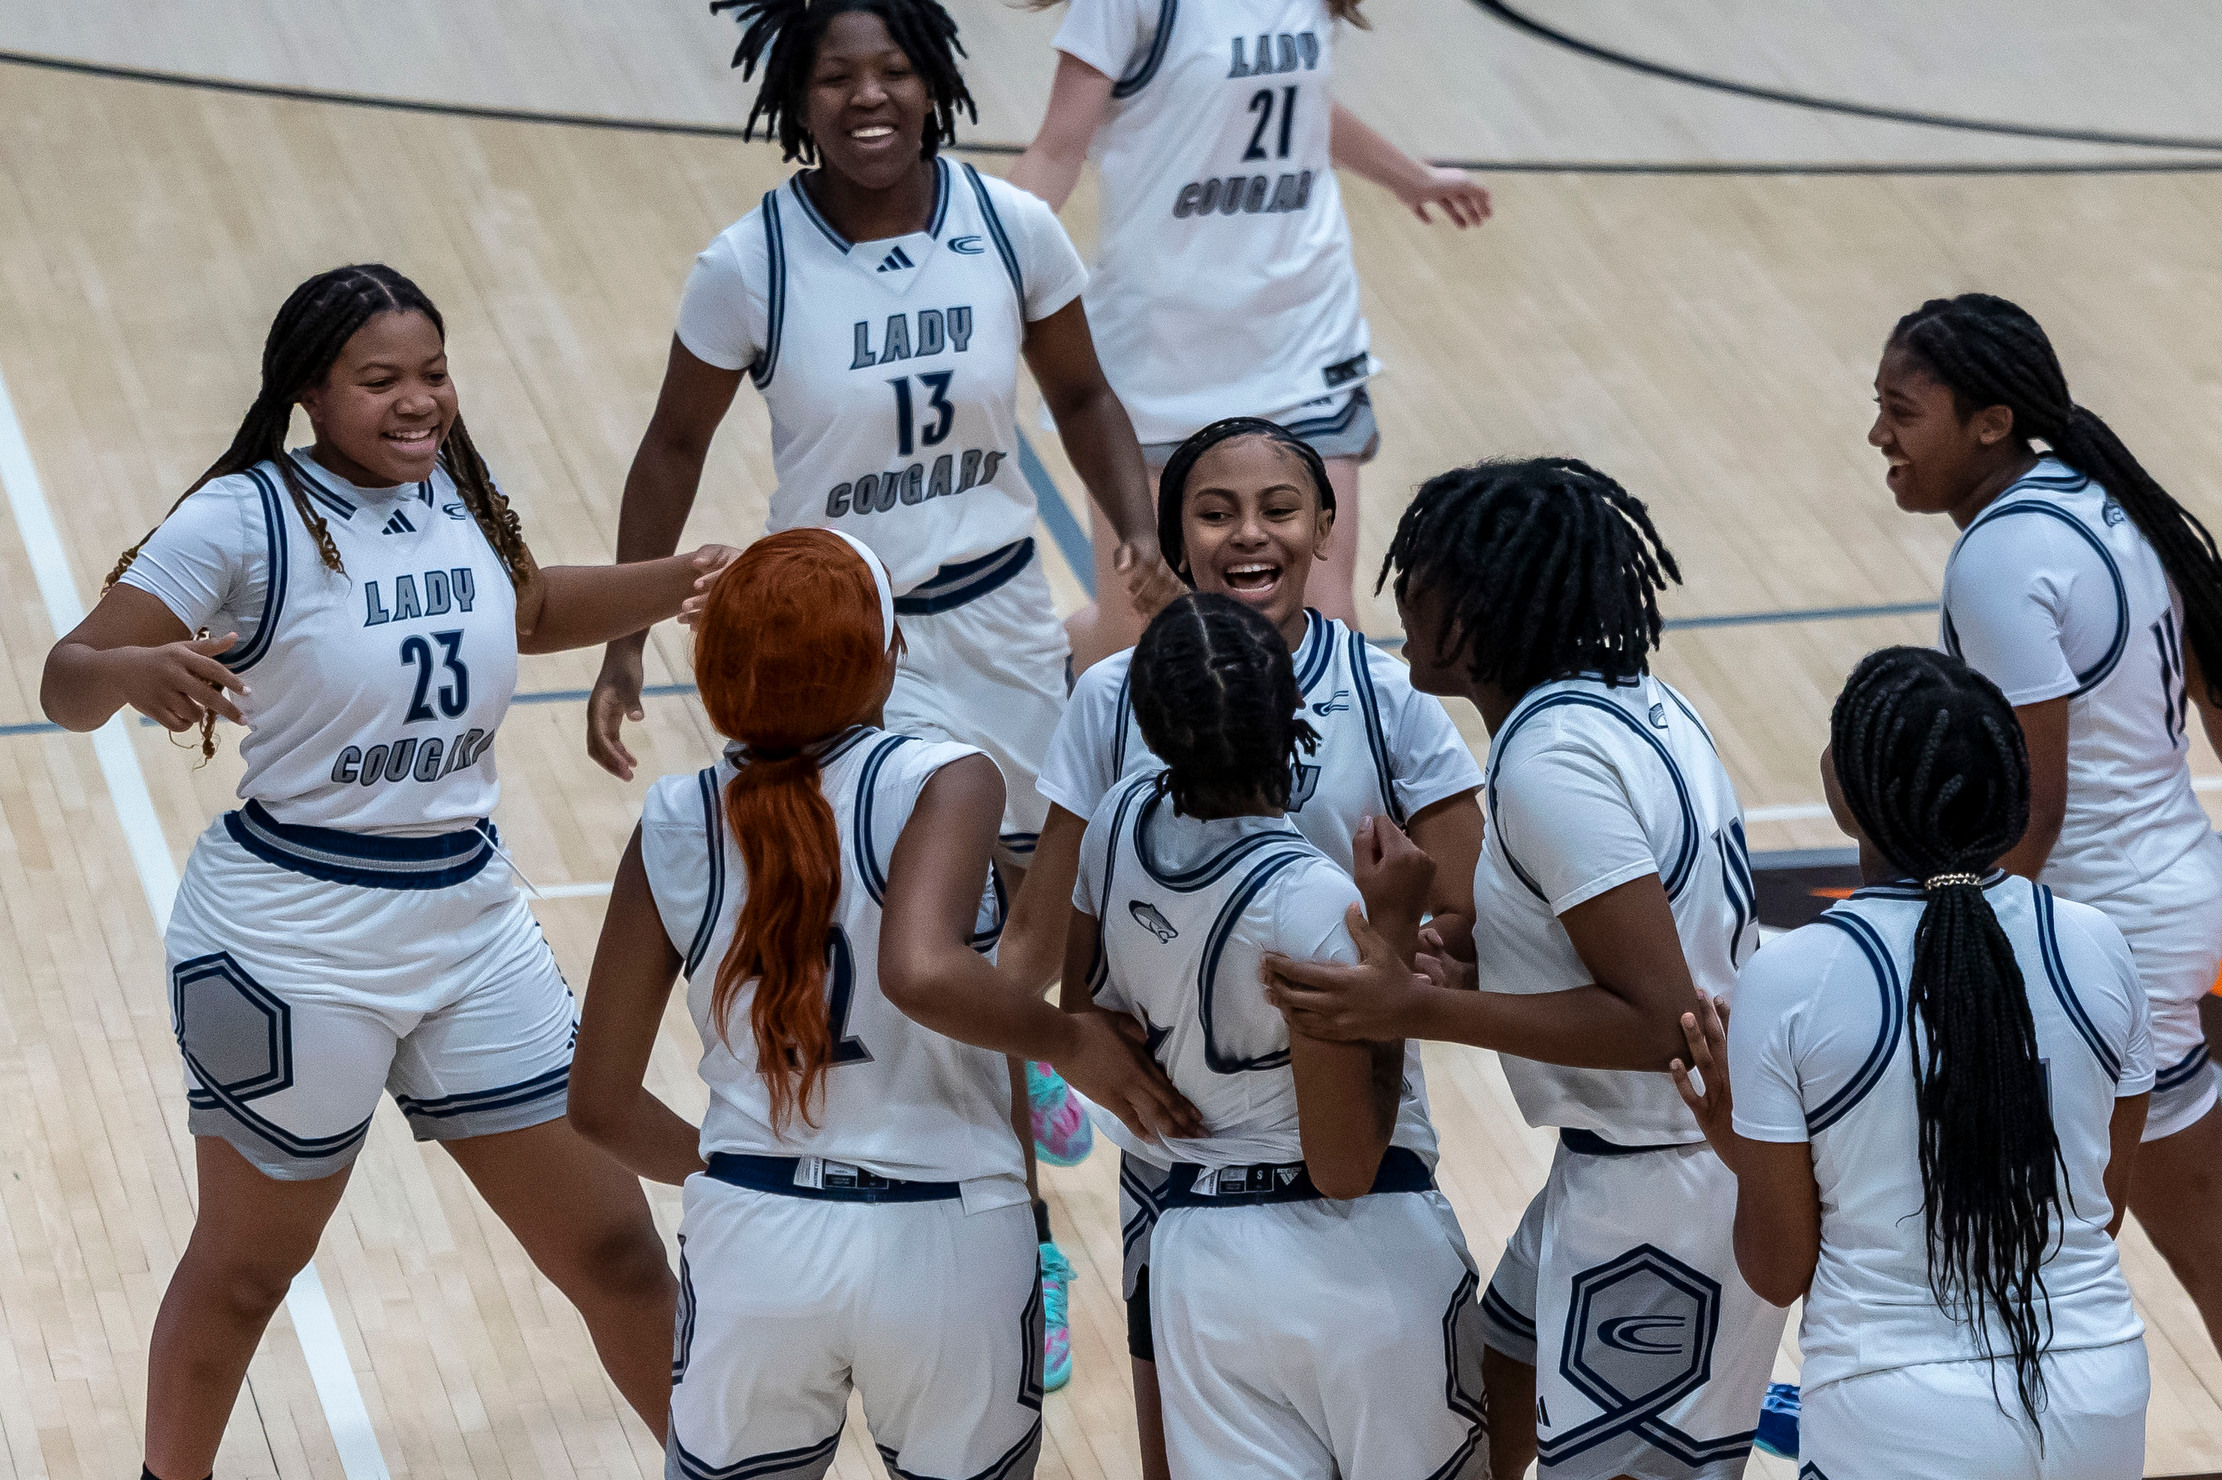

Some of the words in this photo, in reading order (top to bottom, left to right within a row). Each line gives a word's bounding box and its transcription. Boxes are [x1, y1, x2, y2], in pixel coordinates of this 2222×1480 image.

[1241, 84, 1298, 162] 21
[849, 306, 973, 370] LADY
[884, 369, 954, 457] 13
[825, 449, 1007, 519] COUGARS
[363, 567, 476, 628] LADY
[399, 628, 470, 727] 23
[1256, 1169, 1264, 1180] S
